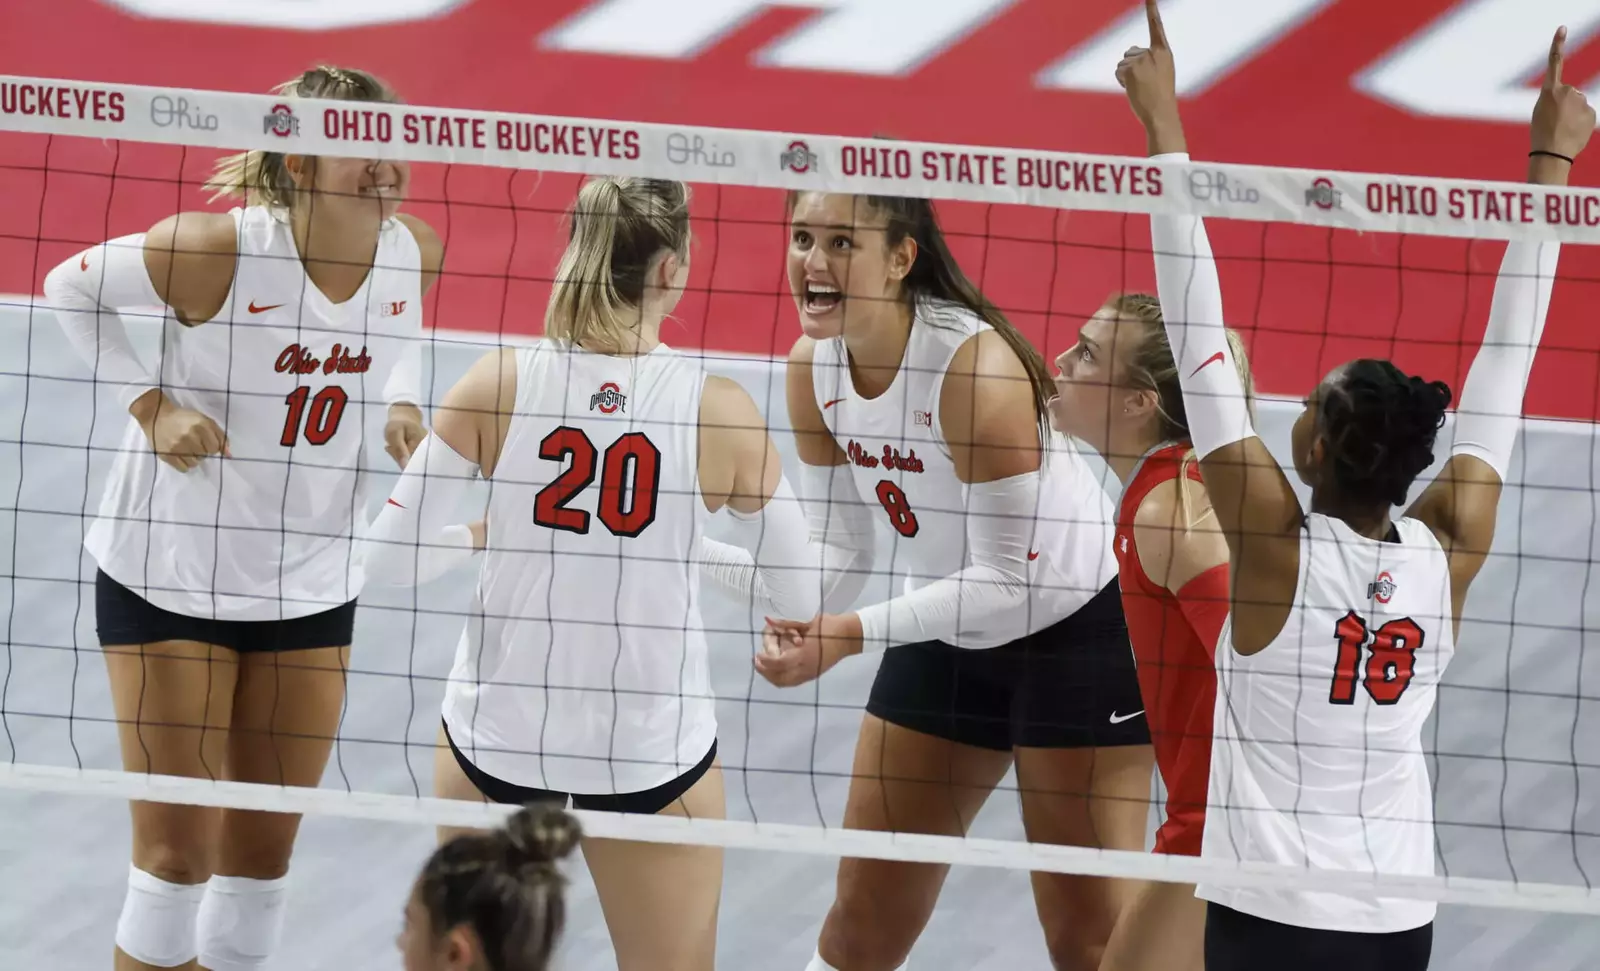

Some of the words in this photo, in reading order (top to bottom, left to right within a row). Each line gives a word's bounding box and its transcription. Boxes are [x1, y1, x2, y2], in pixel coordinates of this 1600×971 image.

[1, 82, 125, 122] UCKEYES
[150, 95, 219, 131] Ohio
[323, 108, 392, 143] OHIO
[404, 114, 486, 149] STATE
[497, 121, 640, 160] BUCKEYES
[666, 132, 736, 167] Ohio
[841, 145, 911, 178] OHIO
[922, 151, 1005, 185] STATE
[1017, 157, 1163, 196] BUCKEYES
[1189, 169, 1260, 203] Ohio
[1367, 183, 1437, 217] OHIO
[1448, 189, 1533, 223] STATE
[1545, 193, 1600, 227] BUC
[275, 343, 320, 375] Ohio
[322, 343, 372, 375] State
[280, 386, 348, 447] 10
[881, 444, 925, 473] State
[533, 425, 661, 538] 20
[875, 479, 919, 538] 8
[1328, 609, 1425, 706] 18
